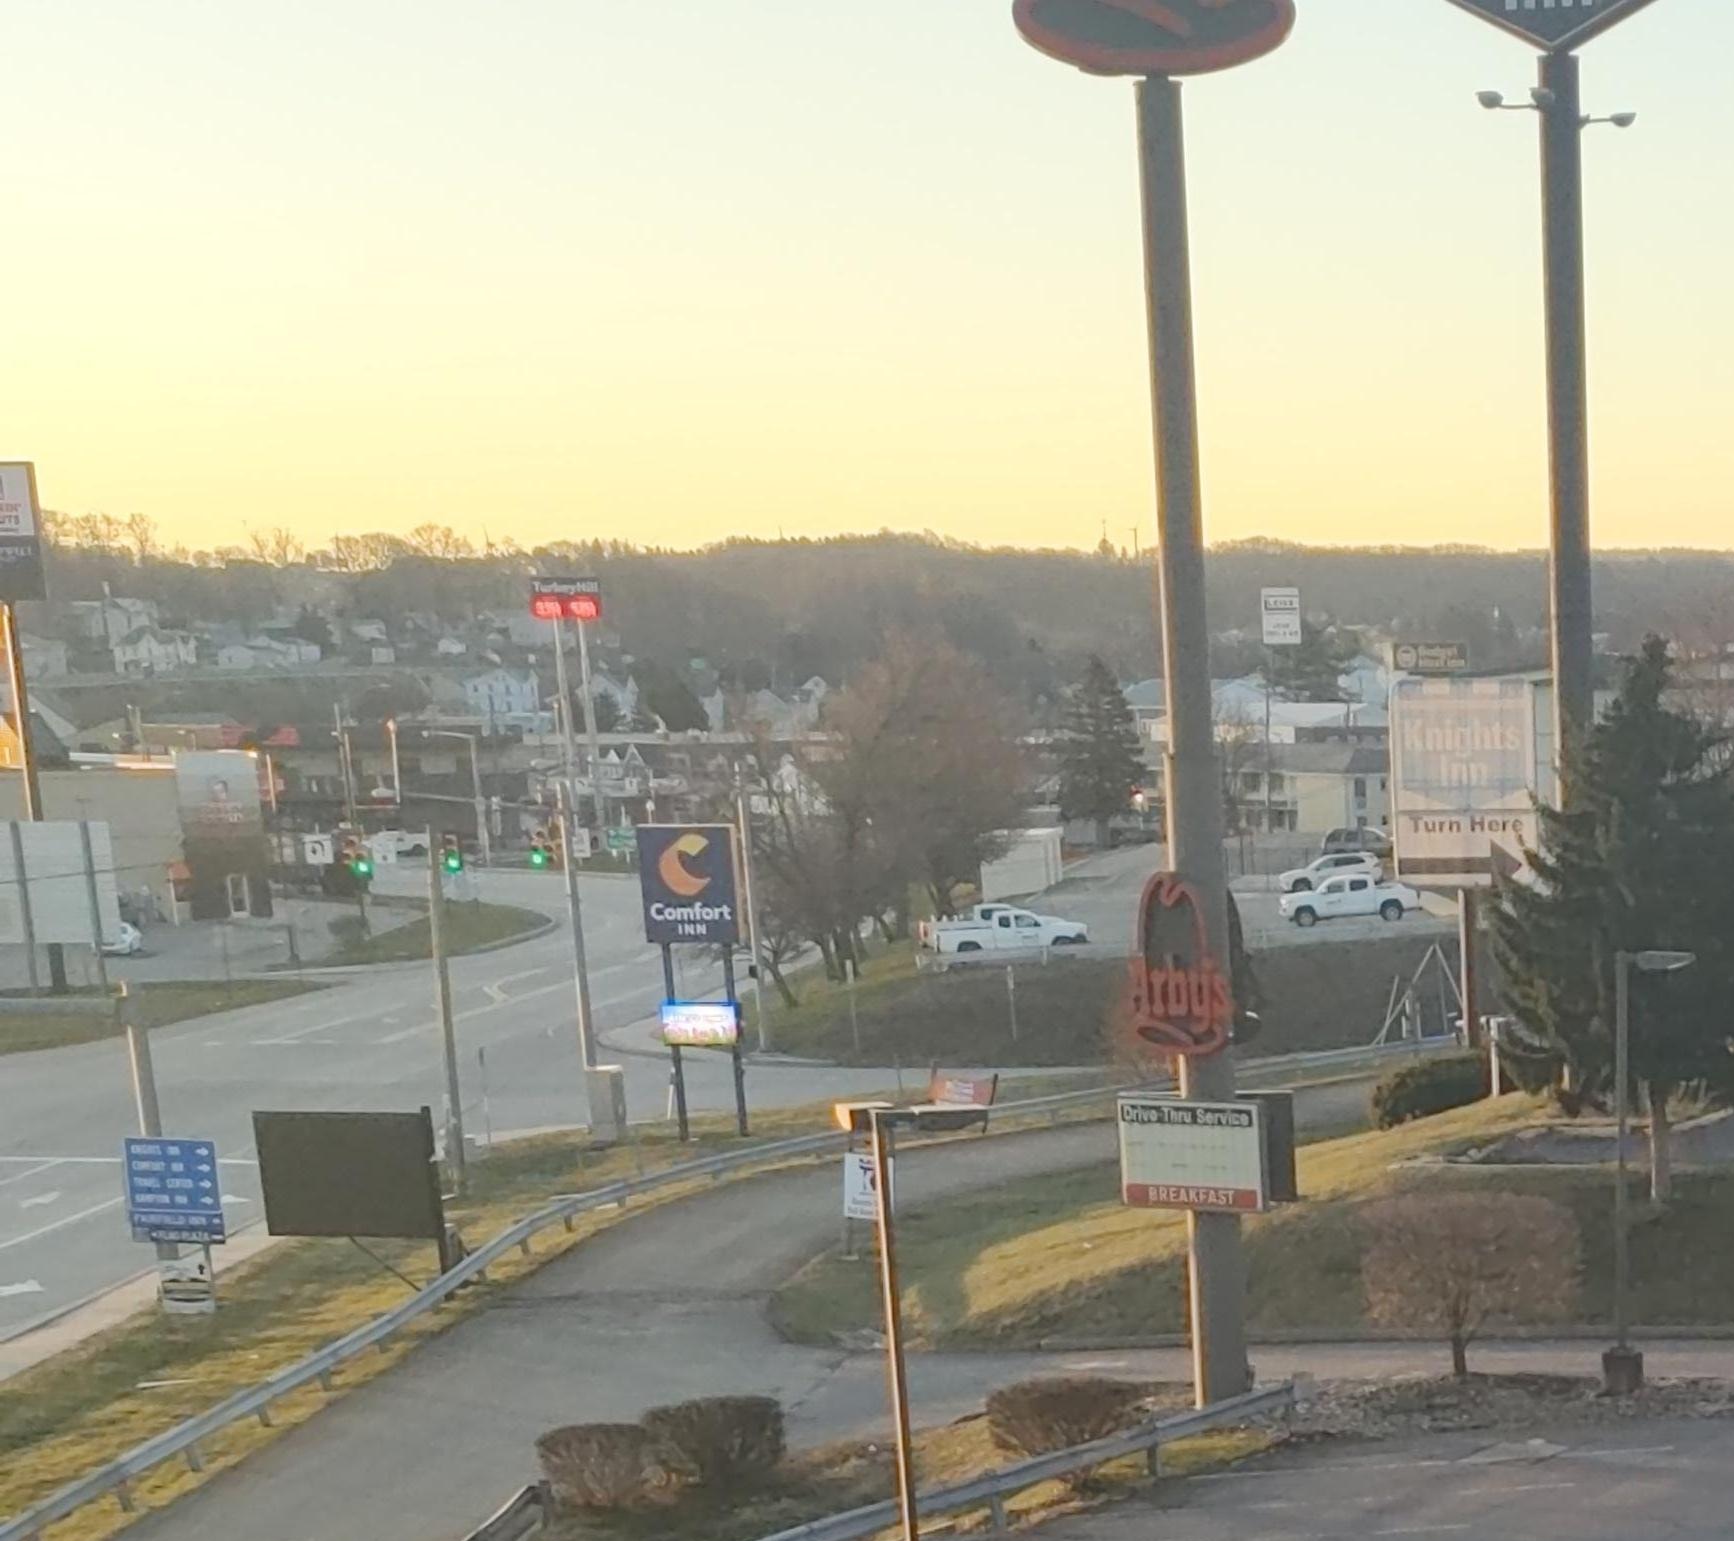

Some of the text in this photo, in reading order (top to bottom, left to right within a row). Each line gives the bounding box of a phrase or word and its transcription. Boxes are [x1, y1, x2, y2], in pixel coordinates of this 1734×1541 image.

[1403, 716, 1521, 758] Knights
[1439, 754, 1490, 786] Inn
[1408, 815, 1525, 834] Turn Here
[650, 901, 732, 921] Comfort
[677, 922, 707, 935] INN
[1127, 953, 1233, 1033] Arby's
[1196, 1108, 1249, 1126] Service
[1149, 1186, 1236, 1206] BREAKFAST
